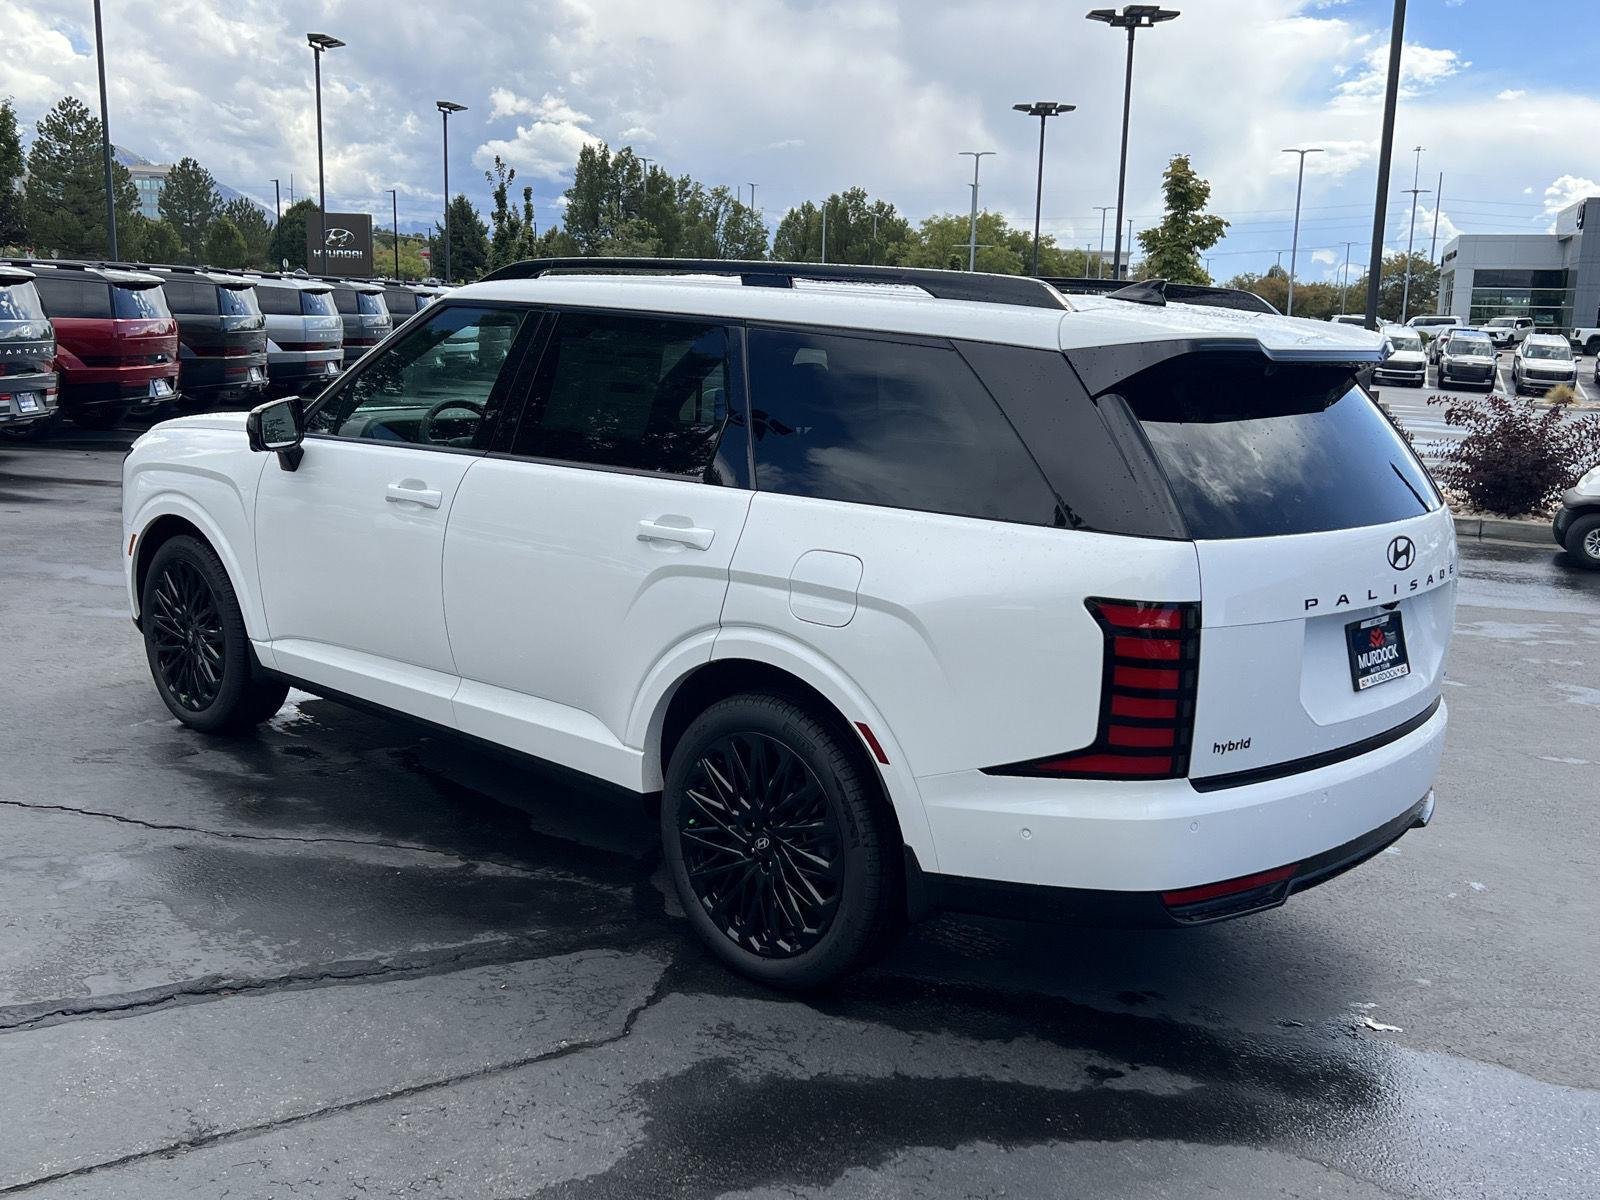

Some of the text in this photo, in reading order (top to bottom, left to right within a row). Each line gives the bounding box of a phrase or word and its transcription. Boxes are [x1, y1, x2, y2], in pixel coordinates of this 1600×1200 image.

[1305, 563, 1454, 611] PALISADE
[1357, 643, 1399, 670] MURDOCK
[1370, 669, 1397, 684] MURDOCK
[1212, 737, 1252, 756] hybrid
